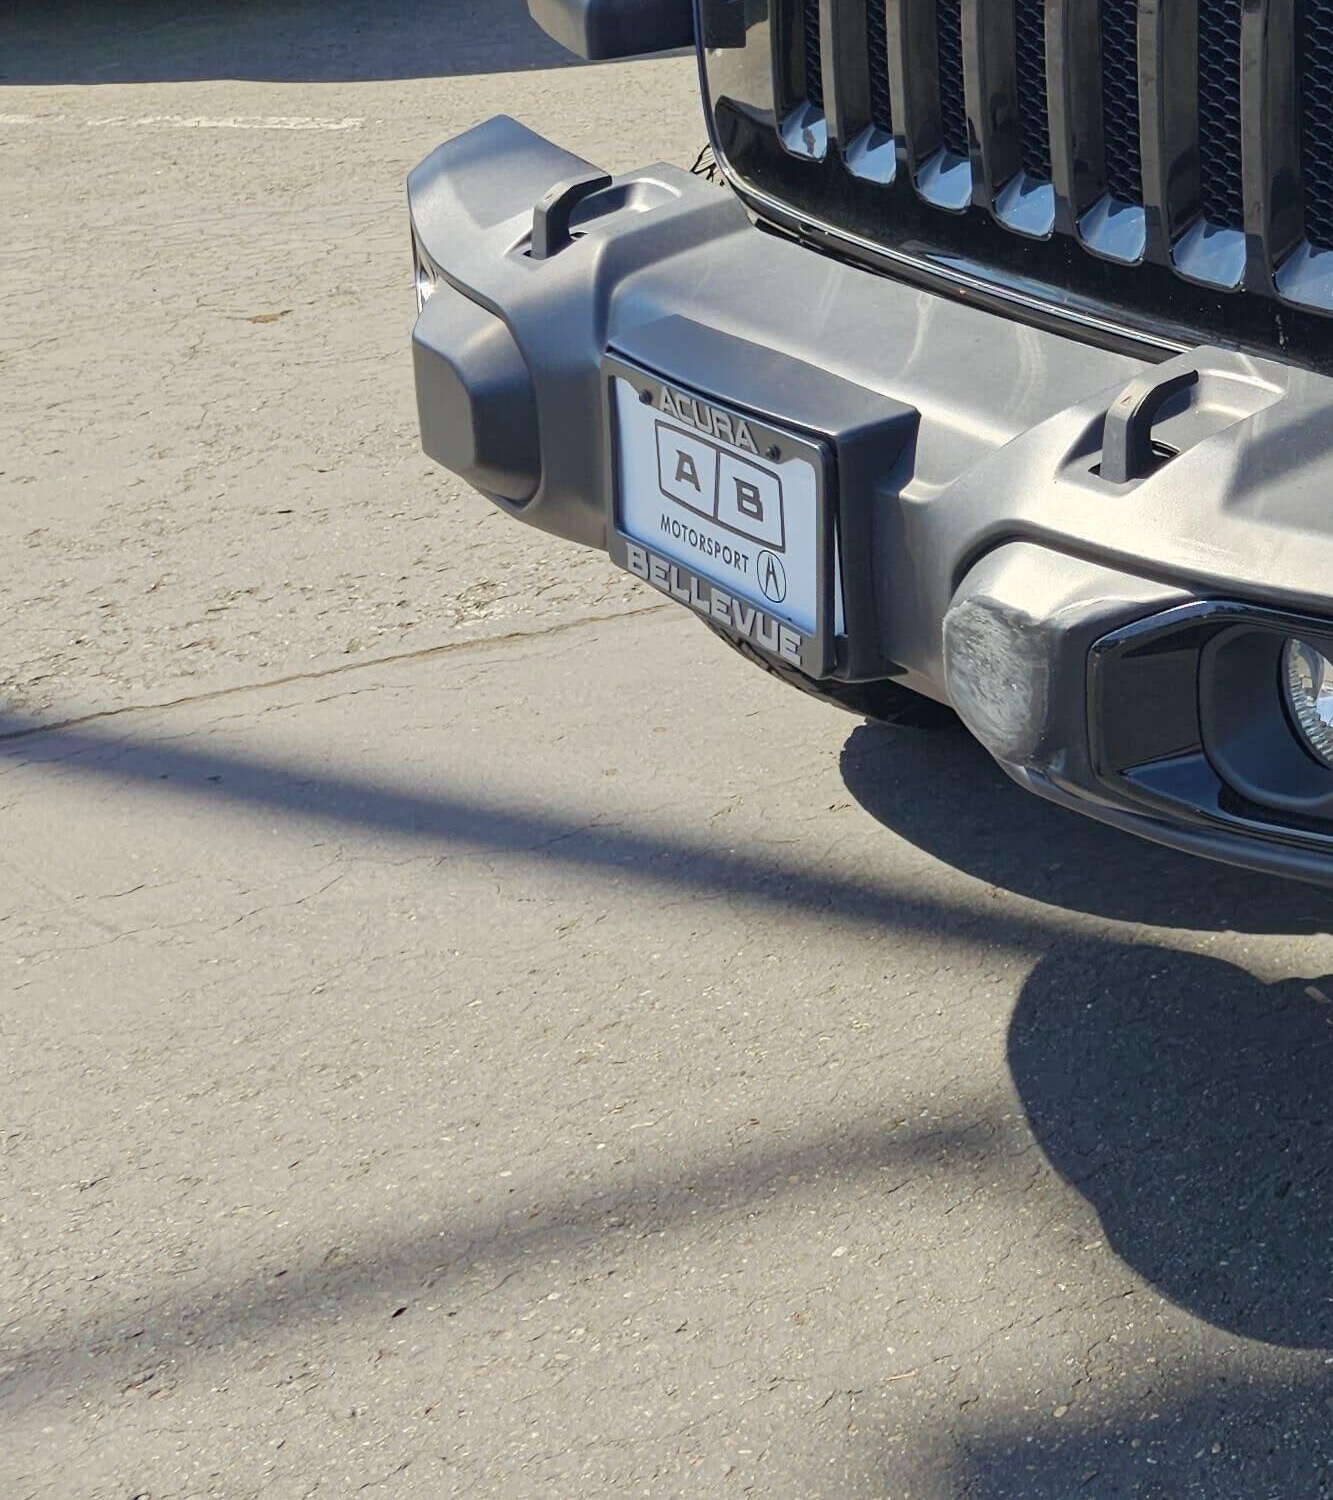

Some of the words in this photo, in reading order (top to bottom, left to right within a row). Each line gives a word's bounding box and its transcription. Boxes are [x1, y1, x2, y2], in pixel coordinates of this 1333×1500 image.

[659, 386, 759, 454] ACURA
[675, 449, 701, 492] A
[732, 476, 764, 522] B
[660, 513, 750, 574] MOTORSPORT
[626, 542, 802, 666] BELLEVUE
